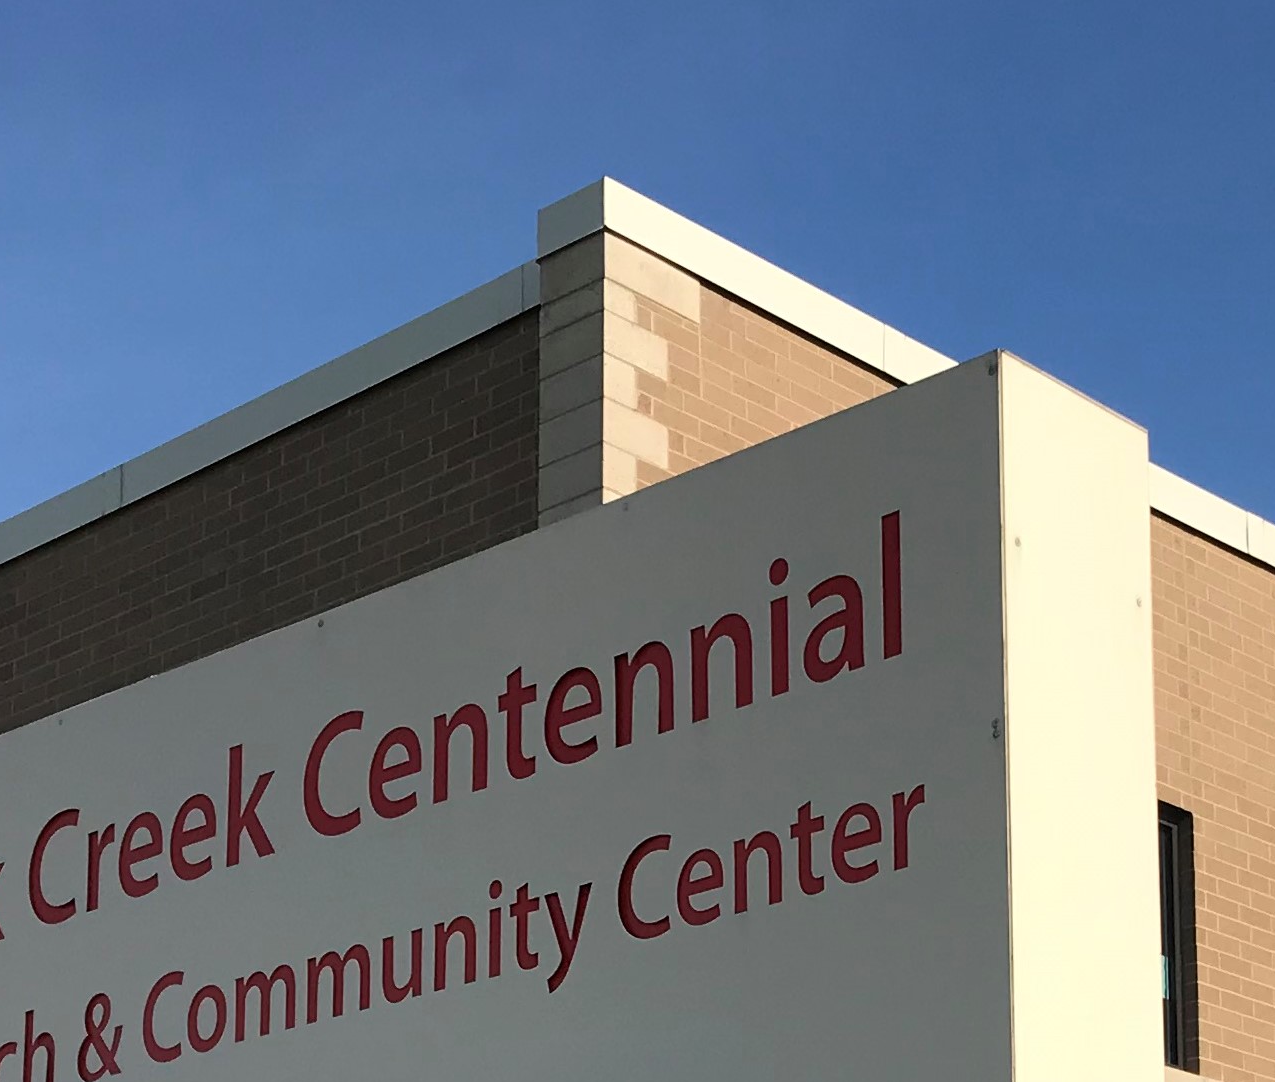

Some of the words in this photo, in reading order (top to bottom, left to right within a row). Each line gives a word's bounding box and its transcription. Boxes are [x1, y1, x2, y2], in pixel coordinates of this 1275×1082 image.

[29, 743, 275, 925] Creek
[304, 509, 903, 836] Centennial
[77, 992, 123, 1082] &
[142, 879, 593, 1063] Community
[617, 784, 926, 940] Center
